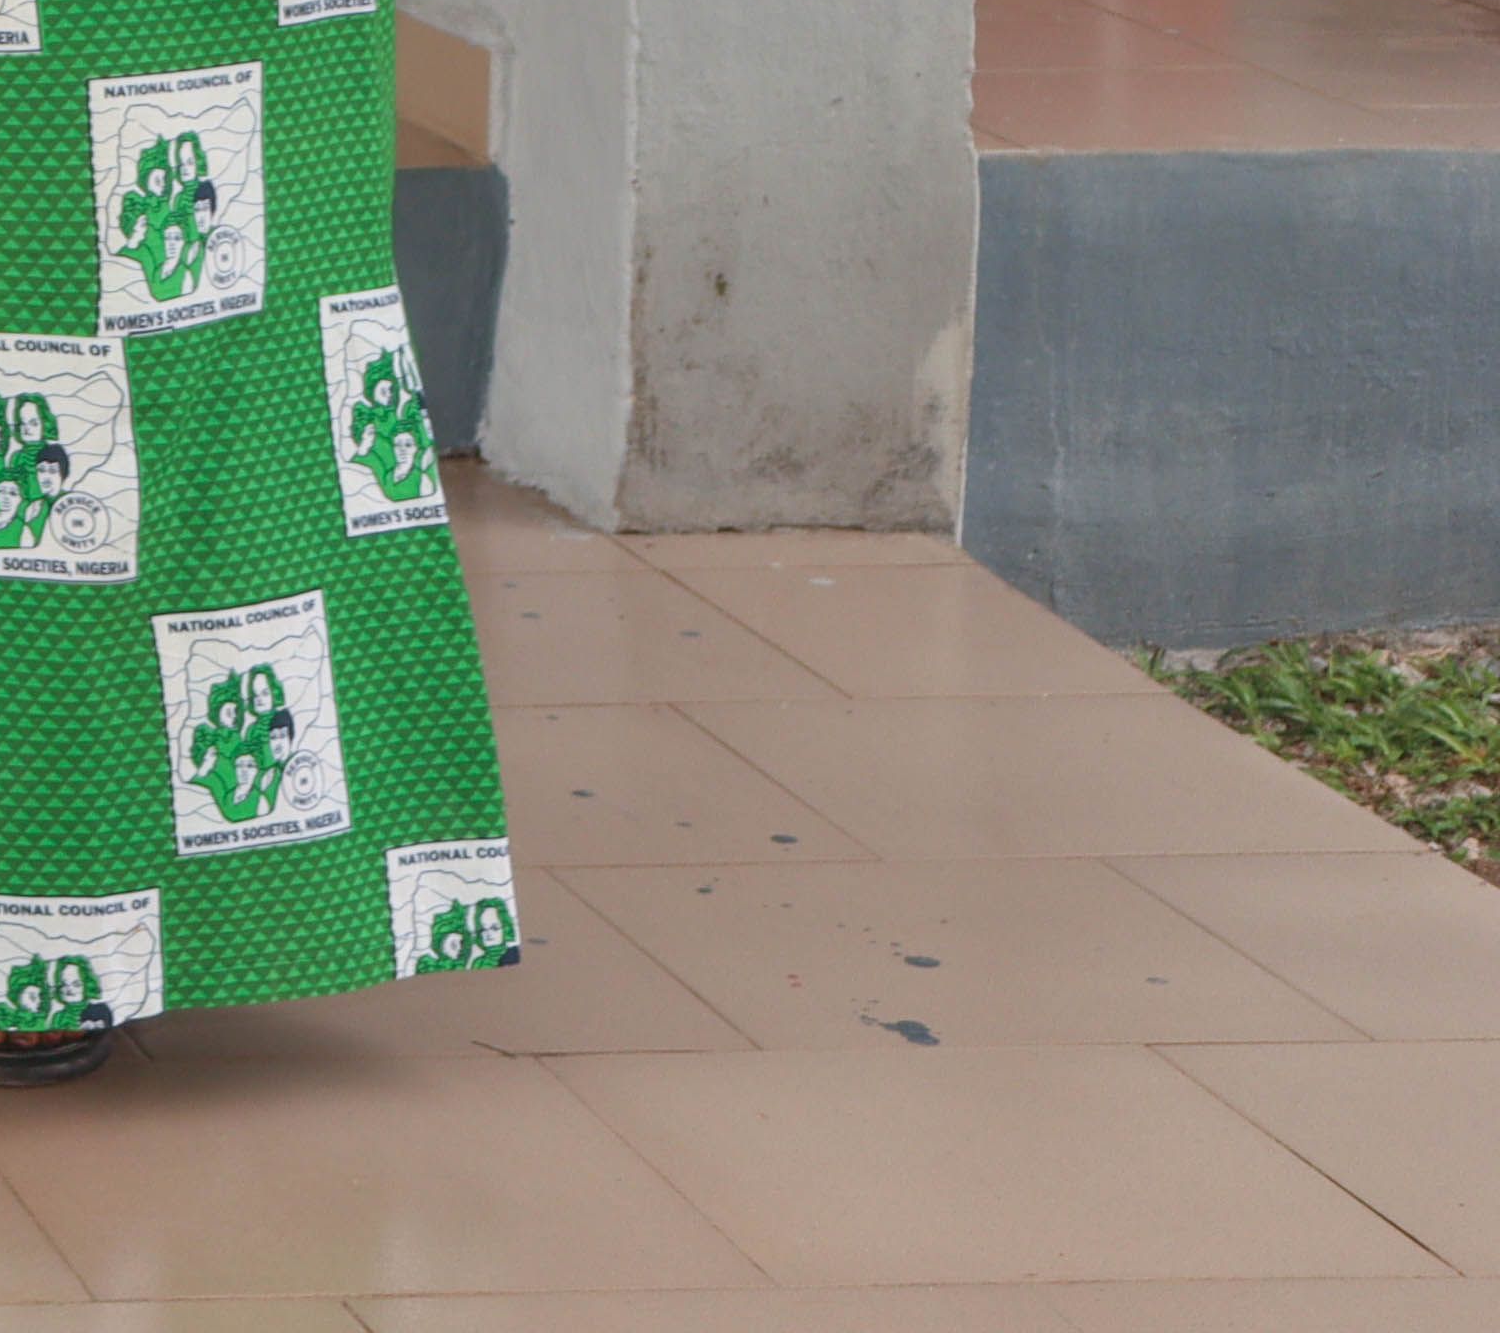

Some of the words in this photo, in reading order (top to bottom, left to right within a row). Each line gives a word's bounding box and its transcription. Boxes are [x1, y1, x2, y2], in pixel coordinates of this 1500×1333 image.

[104, 81, 175, 99] NATIONAL
[176, 73, 232, 91] COUNCIL
[235, 70, 253, 82] OF
[103, 310, 164, 331] WOMEN'S
[220, 293, 257, 310] NIGERIA
[15, 339, 85, 356] COUNCIL
[89, 343, 112, 357] OF
[3, 556, 72, 576] SOCIETIES,
[75, 561, 129, 576] NIGERIA
[168, 619, 244, 633] NATIONAL
[246, 605, 300, 625] COUNCIL
[303, 598, 317, 612] OF
[182, 831, 240, 849] WOMEN'S
[305, 810, 343, 830] NIGERIA
[398, 848, 473, 866] NATIONAL
[58, 903, 128, 917] COUNCIL
[131, 897, 150, 910] OF
